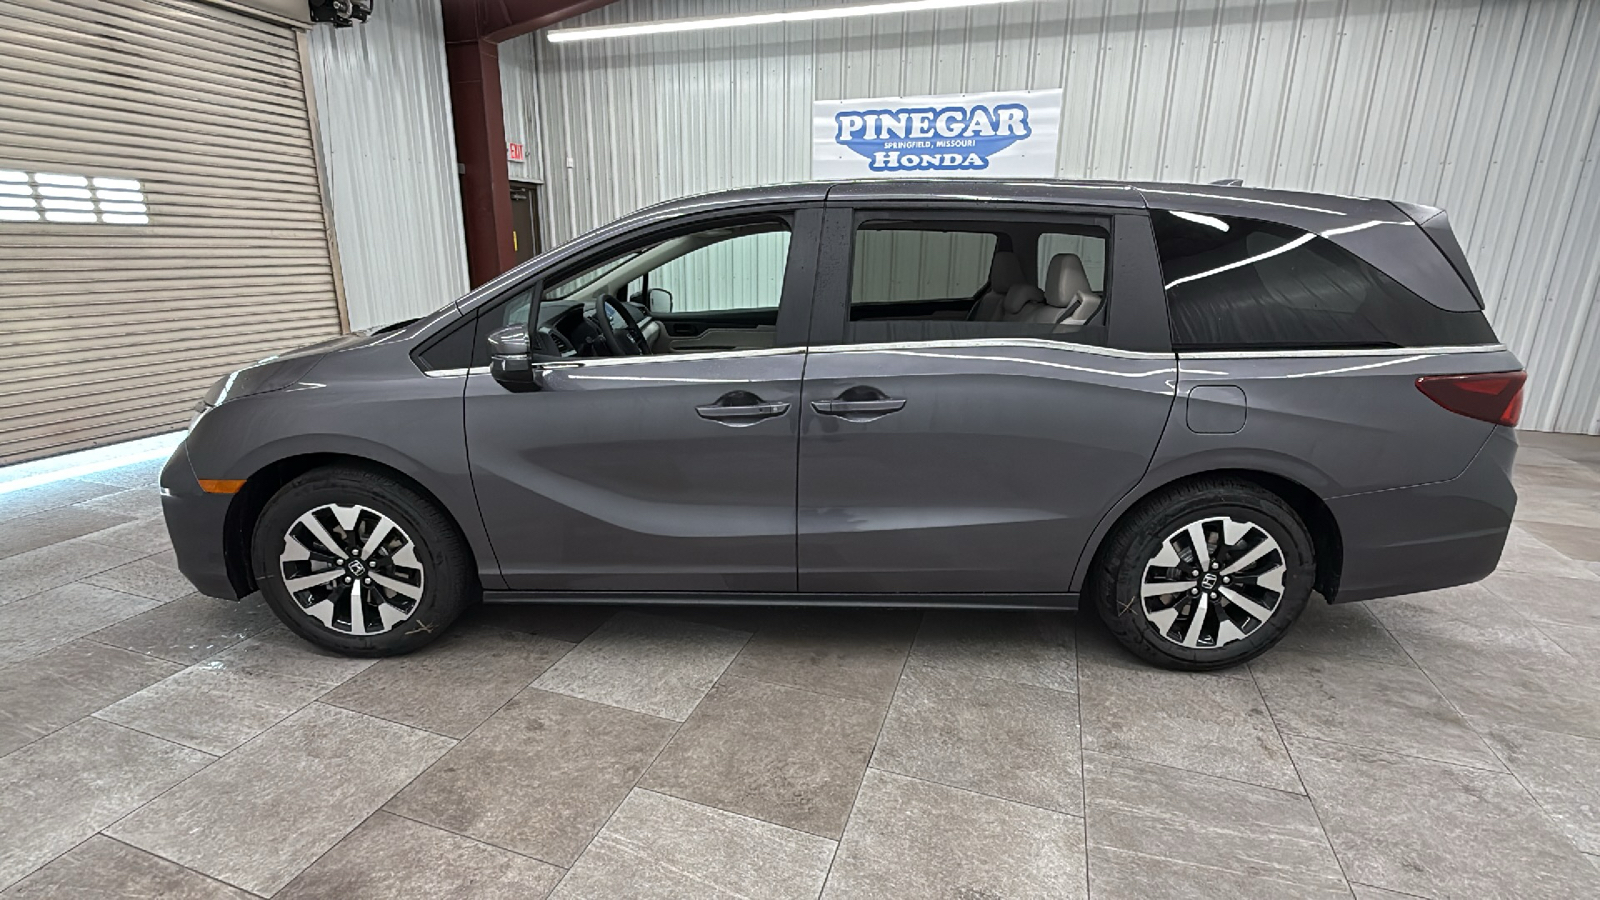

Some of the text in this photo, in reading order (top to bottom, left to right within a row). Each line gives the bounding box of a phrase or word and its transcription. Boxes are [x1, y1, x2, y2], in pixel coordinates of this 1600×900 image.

[839, 108, 1029, 141] PINEGAR
[884, 139, 976, 149] SPRINGFIELD, MISSOURI
[873, 151, 985, 168] HONDA
